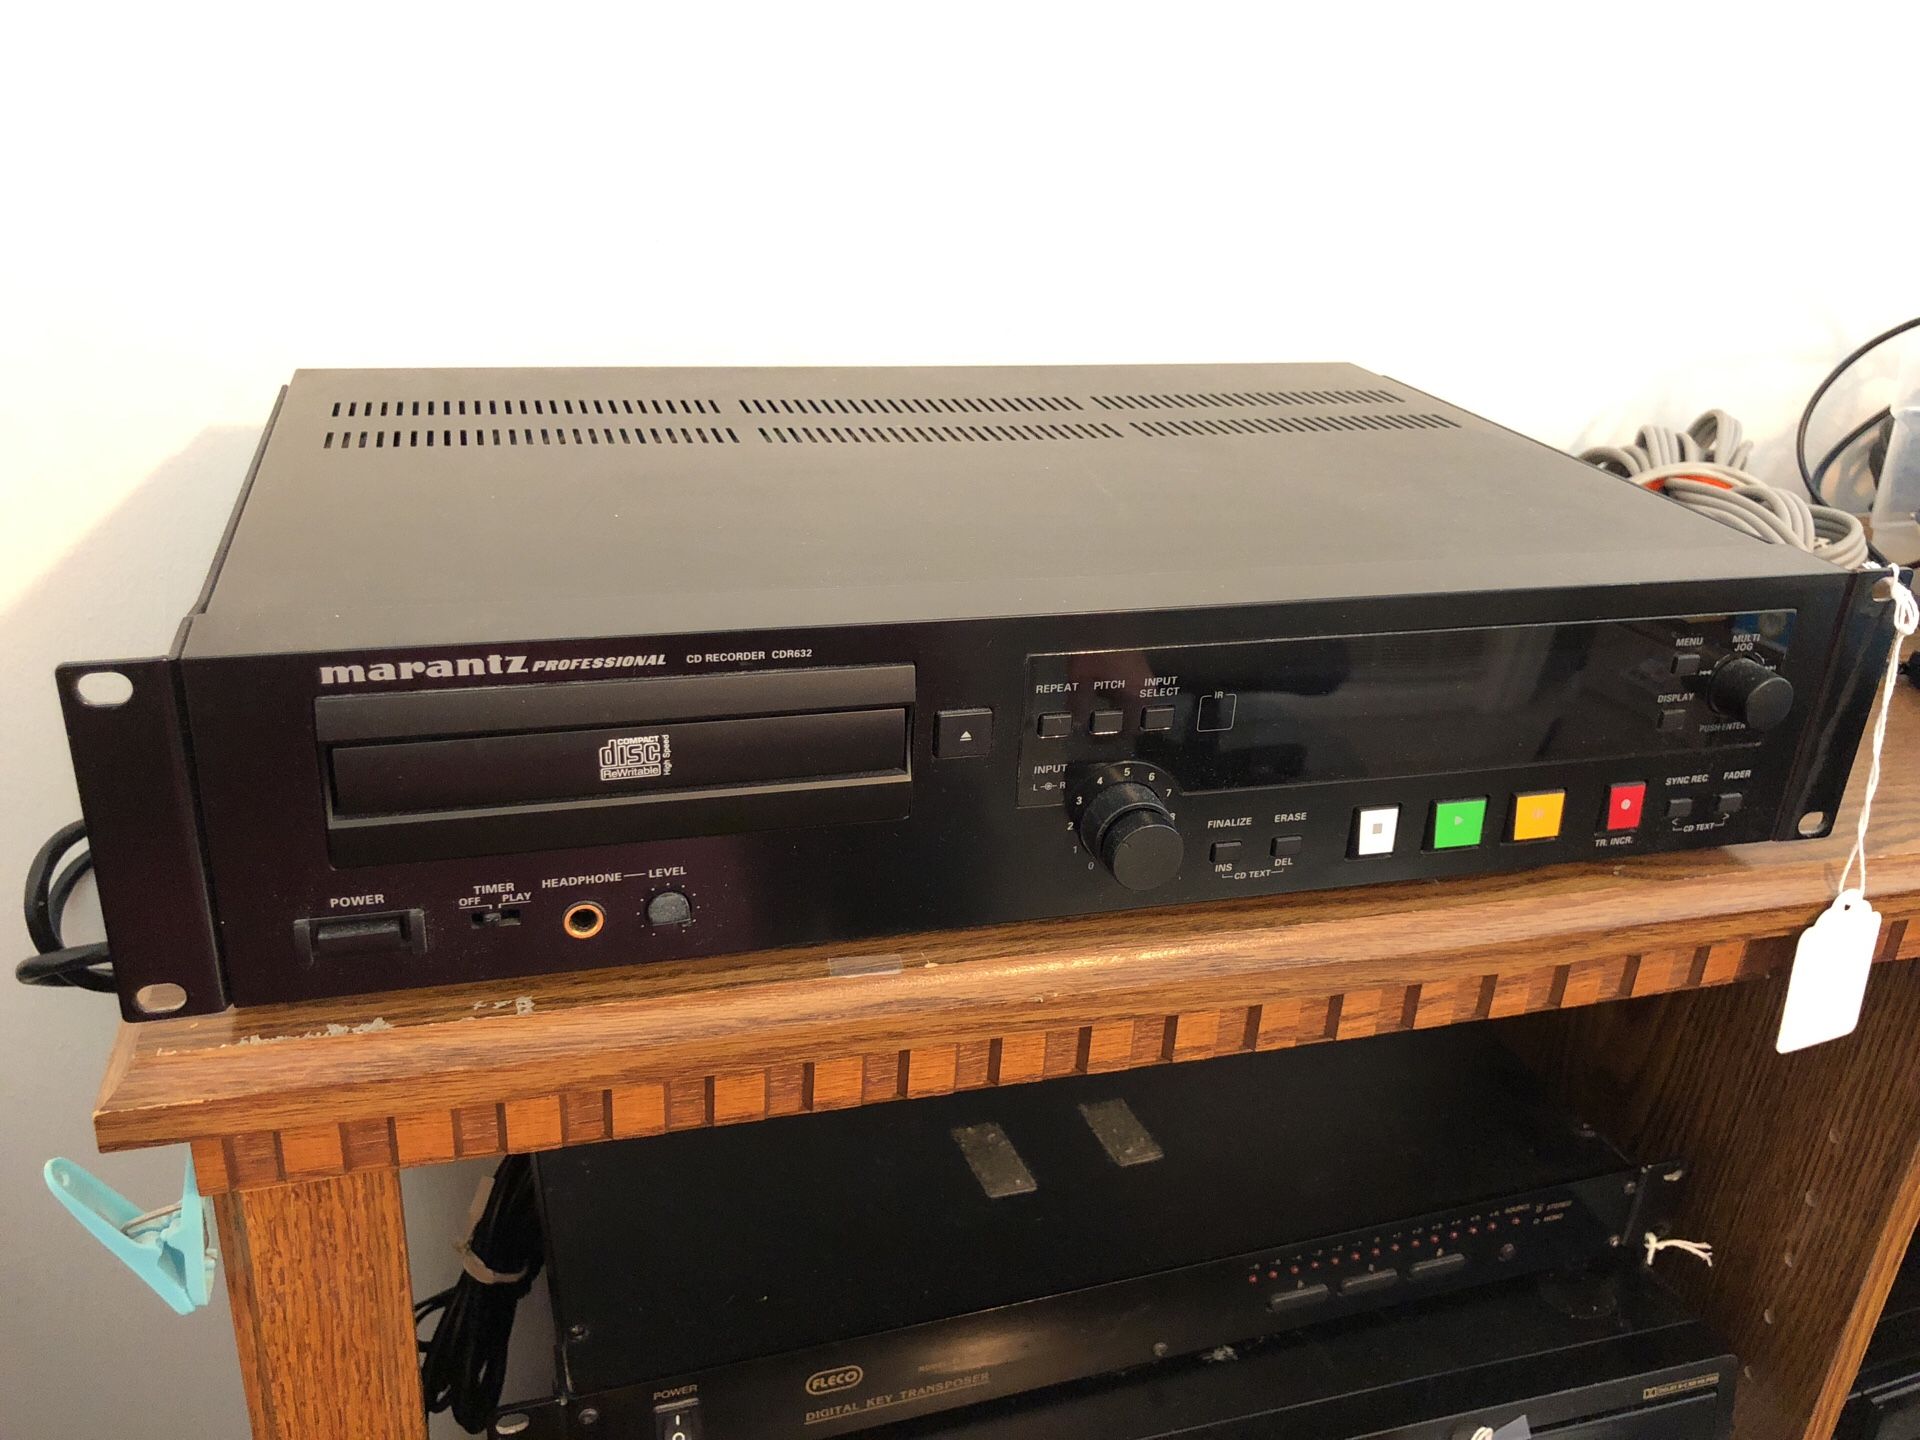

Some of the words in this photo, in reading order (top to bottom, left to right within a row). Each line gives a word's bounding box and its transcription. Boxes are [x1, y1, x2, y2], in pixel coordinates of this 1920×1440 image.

[1675, 637, 1704, 647] MENU
[1732, 633, 1761, 644] MULTI
[1734, 643, 1753, 652] JOG
[686, 654, 702, 664] CD
[705, 651, 766, 663] RECORDER
[771, 649, 813, 660] CDR632
[319, 654, 529, 685] marantz
[531, 654, 667, 673] PROFESSIONAL
[1093, 679, 1126, 690] PITCH
[1143, 676, 1179, 687] INPUT
[1035, 682, 1080, 695] REPEAT
[1139, 687, 1181, 698] SELECT
[1214, 691, 1224, 699] IR
[1657, 692, 1695, 703] DISPLAY
[617, 735, 660, 746] COMPACT
[661, 734, 672, 759] Speed
[599, 739, 661, 768] disc
[603, 766, 659, 779] ReWritable
[663, 759, 673, 776] High
[1033, 763, 1068, 774] INPUT
[1124, 767, 1131, 777] 5
[1148, 772, 1156, 781] 6
[1665, 775, 1689, 786] SYNC
[1690, 773, 1710, 784] REC
[1723, 769, 1752, 780] FADER
[1059, 781, 1066, 789] R
[1096, 776, 1104, 785] 4
[1165, 788, 1172, 797] 7
[1076, 796, 1083, 805] 3
[1207, 816, 1253, 829] FINALIZE
[1274, 811, 1308, 823] ERASE
[1067, 821, 1074, 831] 2
[1683, 823, 1694, 832] CD
[1695, 822, 1716, 831] TEXT
[1594, 838, 1608, 848] TR.
[1609, 836, 1633, 847] INCR.
[1072, 845, 1078, 854] 1
[1087, 861, 1095, 870] 0
[1274, 857, 1293, 867] DEL
[1214, 863, 1233, 873] INS
[541, 872, 623, 889] HEADPHONE
[648, 866, 687, 879] LEVEL
[1233, 872, 1247, 880] CD
[1248, 869, 1272, 879] TEXT
[473, 882, 516, 895] TIMER
[329, 893, 385, 909] POWER
[458, 896, 482, 907] OFF
[501, 892, 532, 903] PLAY
[810, 1371, 858, 1391] FLECO
[653, 1384, 698, 1401] POWER
[805, 1401, 859, 1422] DIGITAL
[865, 1393, 894, 1408] KEY
[900, 1371, 991, 1400] TRANSPOSER
